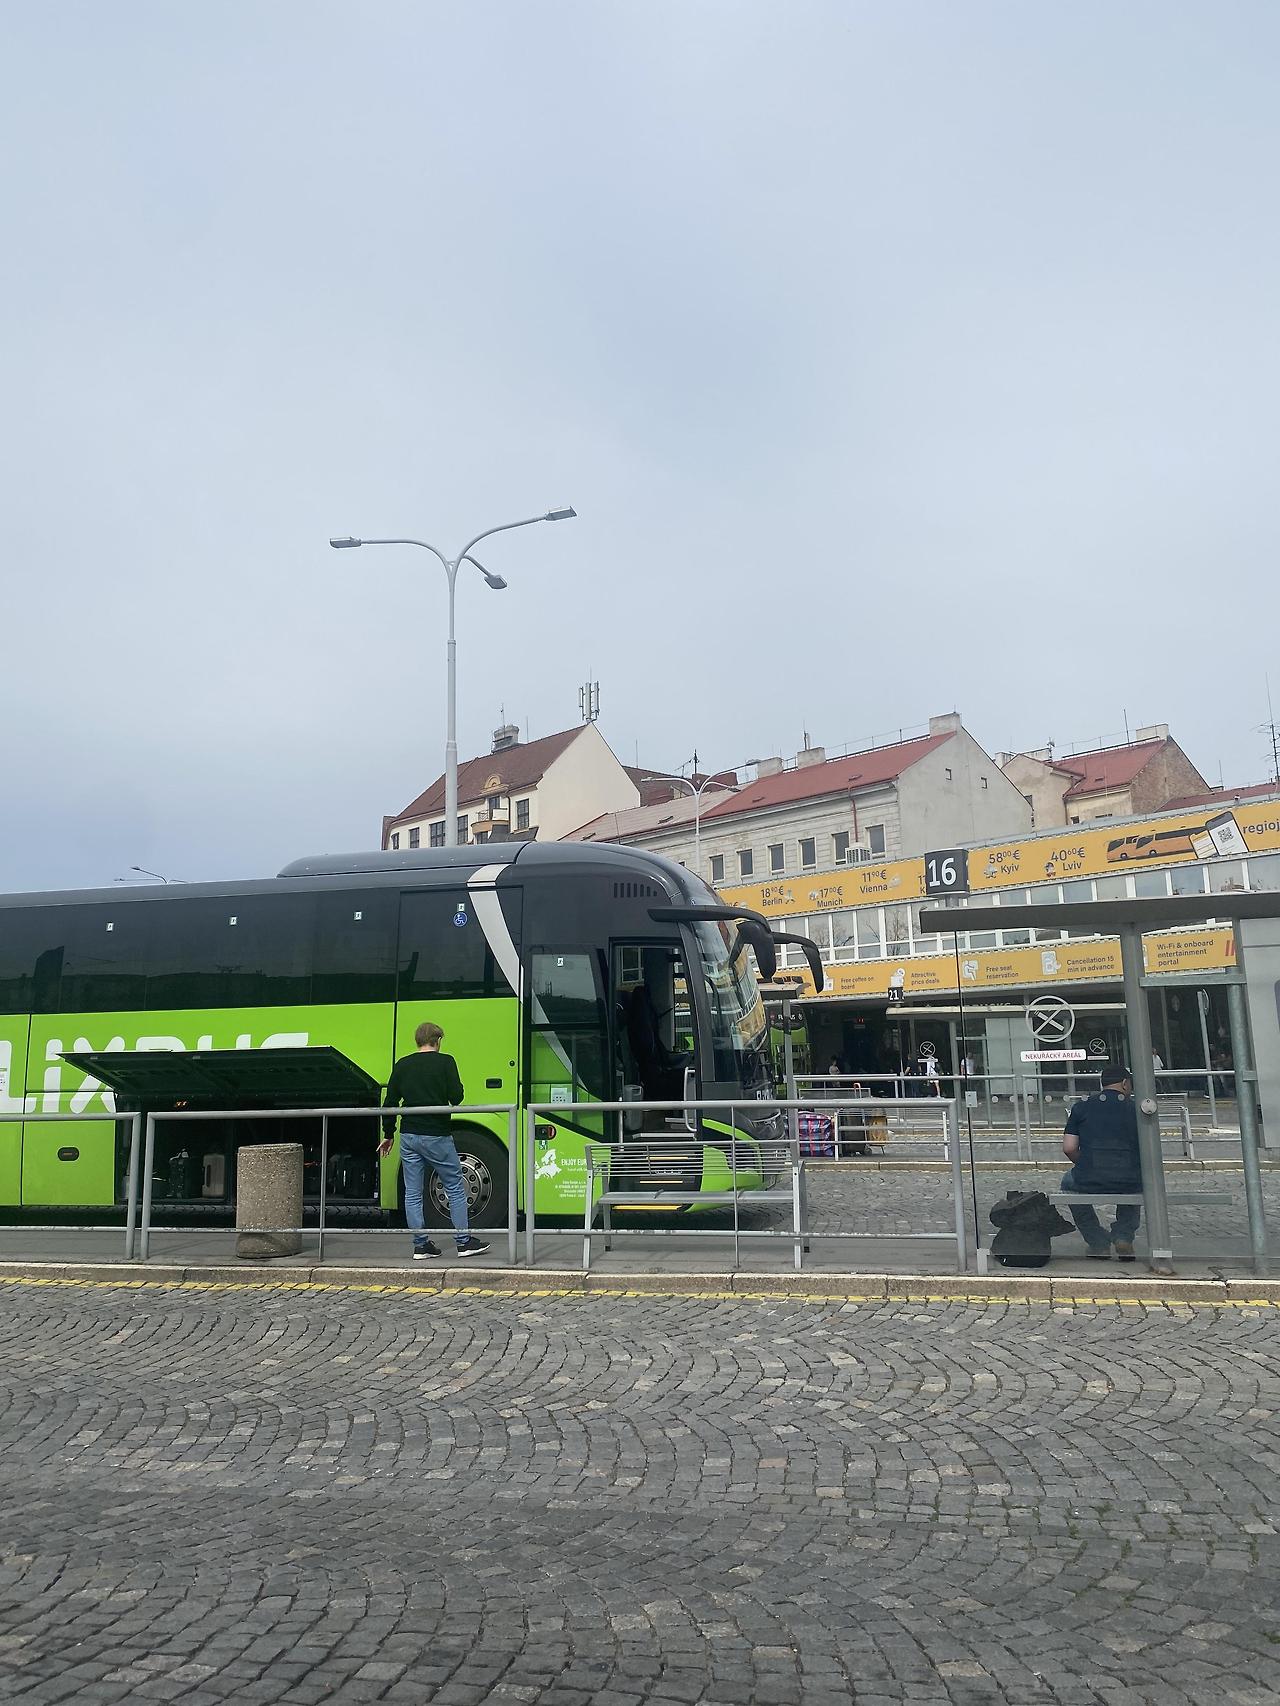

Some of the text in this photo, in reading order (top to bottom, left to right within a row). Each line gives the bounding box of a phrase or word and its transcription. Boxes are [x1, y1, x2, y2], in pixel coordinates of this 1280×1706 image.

[1001, 864, 1019, 875] Kyiv
[1063, 861, 1082, 871] Lviv
[929, 857, 957, 887] 16
[860, 885, 888, 894] Vienna
[762, 898, 783, 907] Berlin
[817, 898, 843, 907] Munich
[1184, 939, 1214, 947] onboard
[1158, 949, 1207, 958] entertainment
[1066, 956, 1105, 965] Cancellation
[1158, 959, 1179, 967] portal
[1088, 963, 1114, 971] advance
[889, 989, 899, 1000] 21
